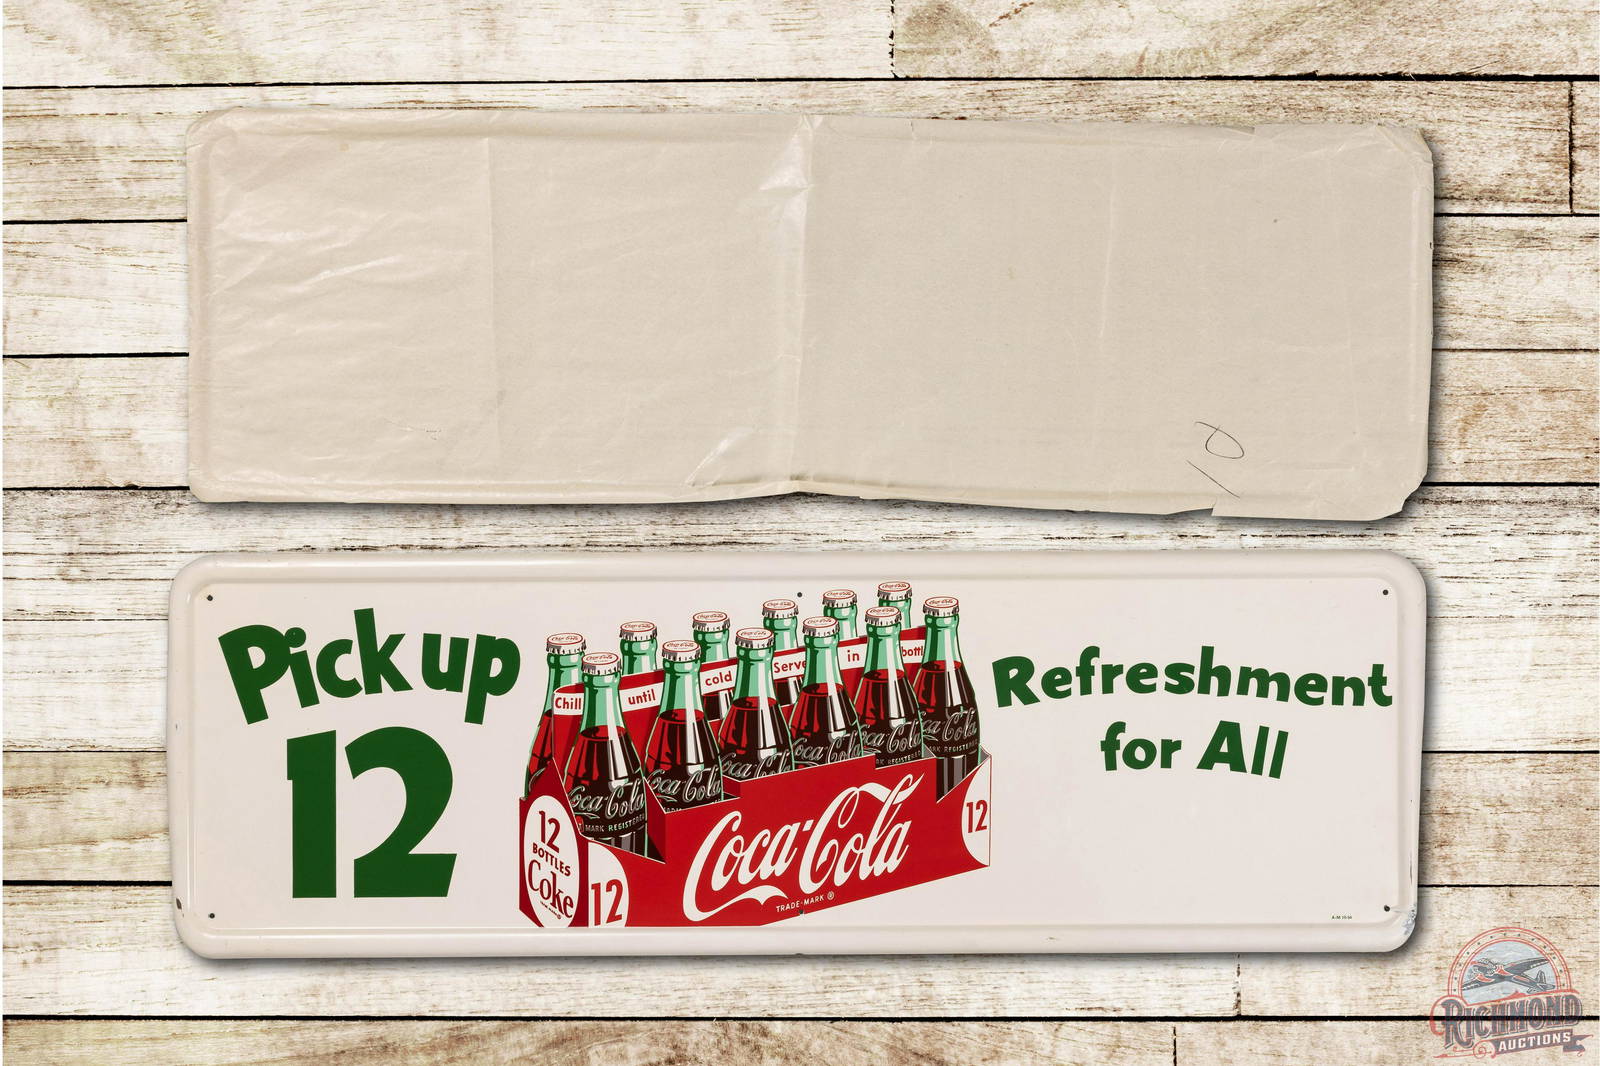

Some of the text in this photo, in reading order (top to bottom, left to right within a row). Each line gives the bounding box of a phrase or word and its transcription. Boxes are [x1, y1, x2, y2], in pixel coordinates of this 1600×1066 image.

[218, 607, 521, 725] Pick up
[554, 697, 582, 710] Chill
[628, 688, 656, 705] until
[705, 671, 733, 686] cold
[773, 660, 807, 673] Serve
[847, 650, 860, 662] in
[991, 645, 1393, 708] Refreshment
[1100, 720, 1289, 779] for All
[286, 726, 458, 899] 12
[538, 810, 561, 854] 12
[966, 799, 988, 834] 12
[532, 842, 571, 877] BOTTLES
[683, 772, 925, 922] Coca-Cola
[528, 859, 574, 919] Coke
[591, 878, 624, 927] 12
